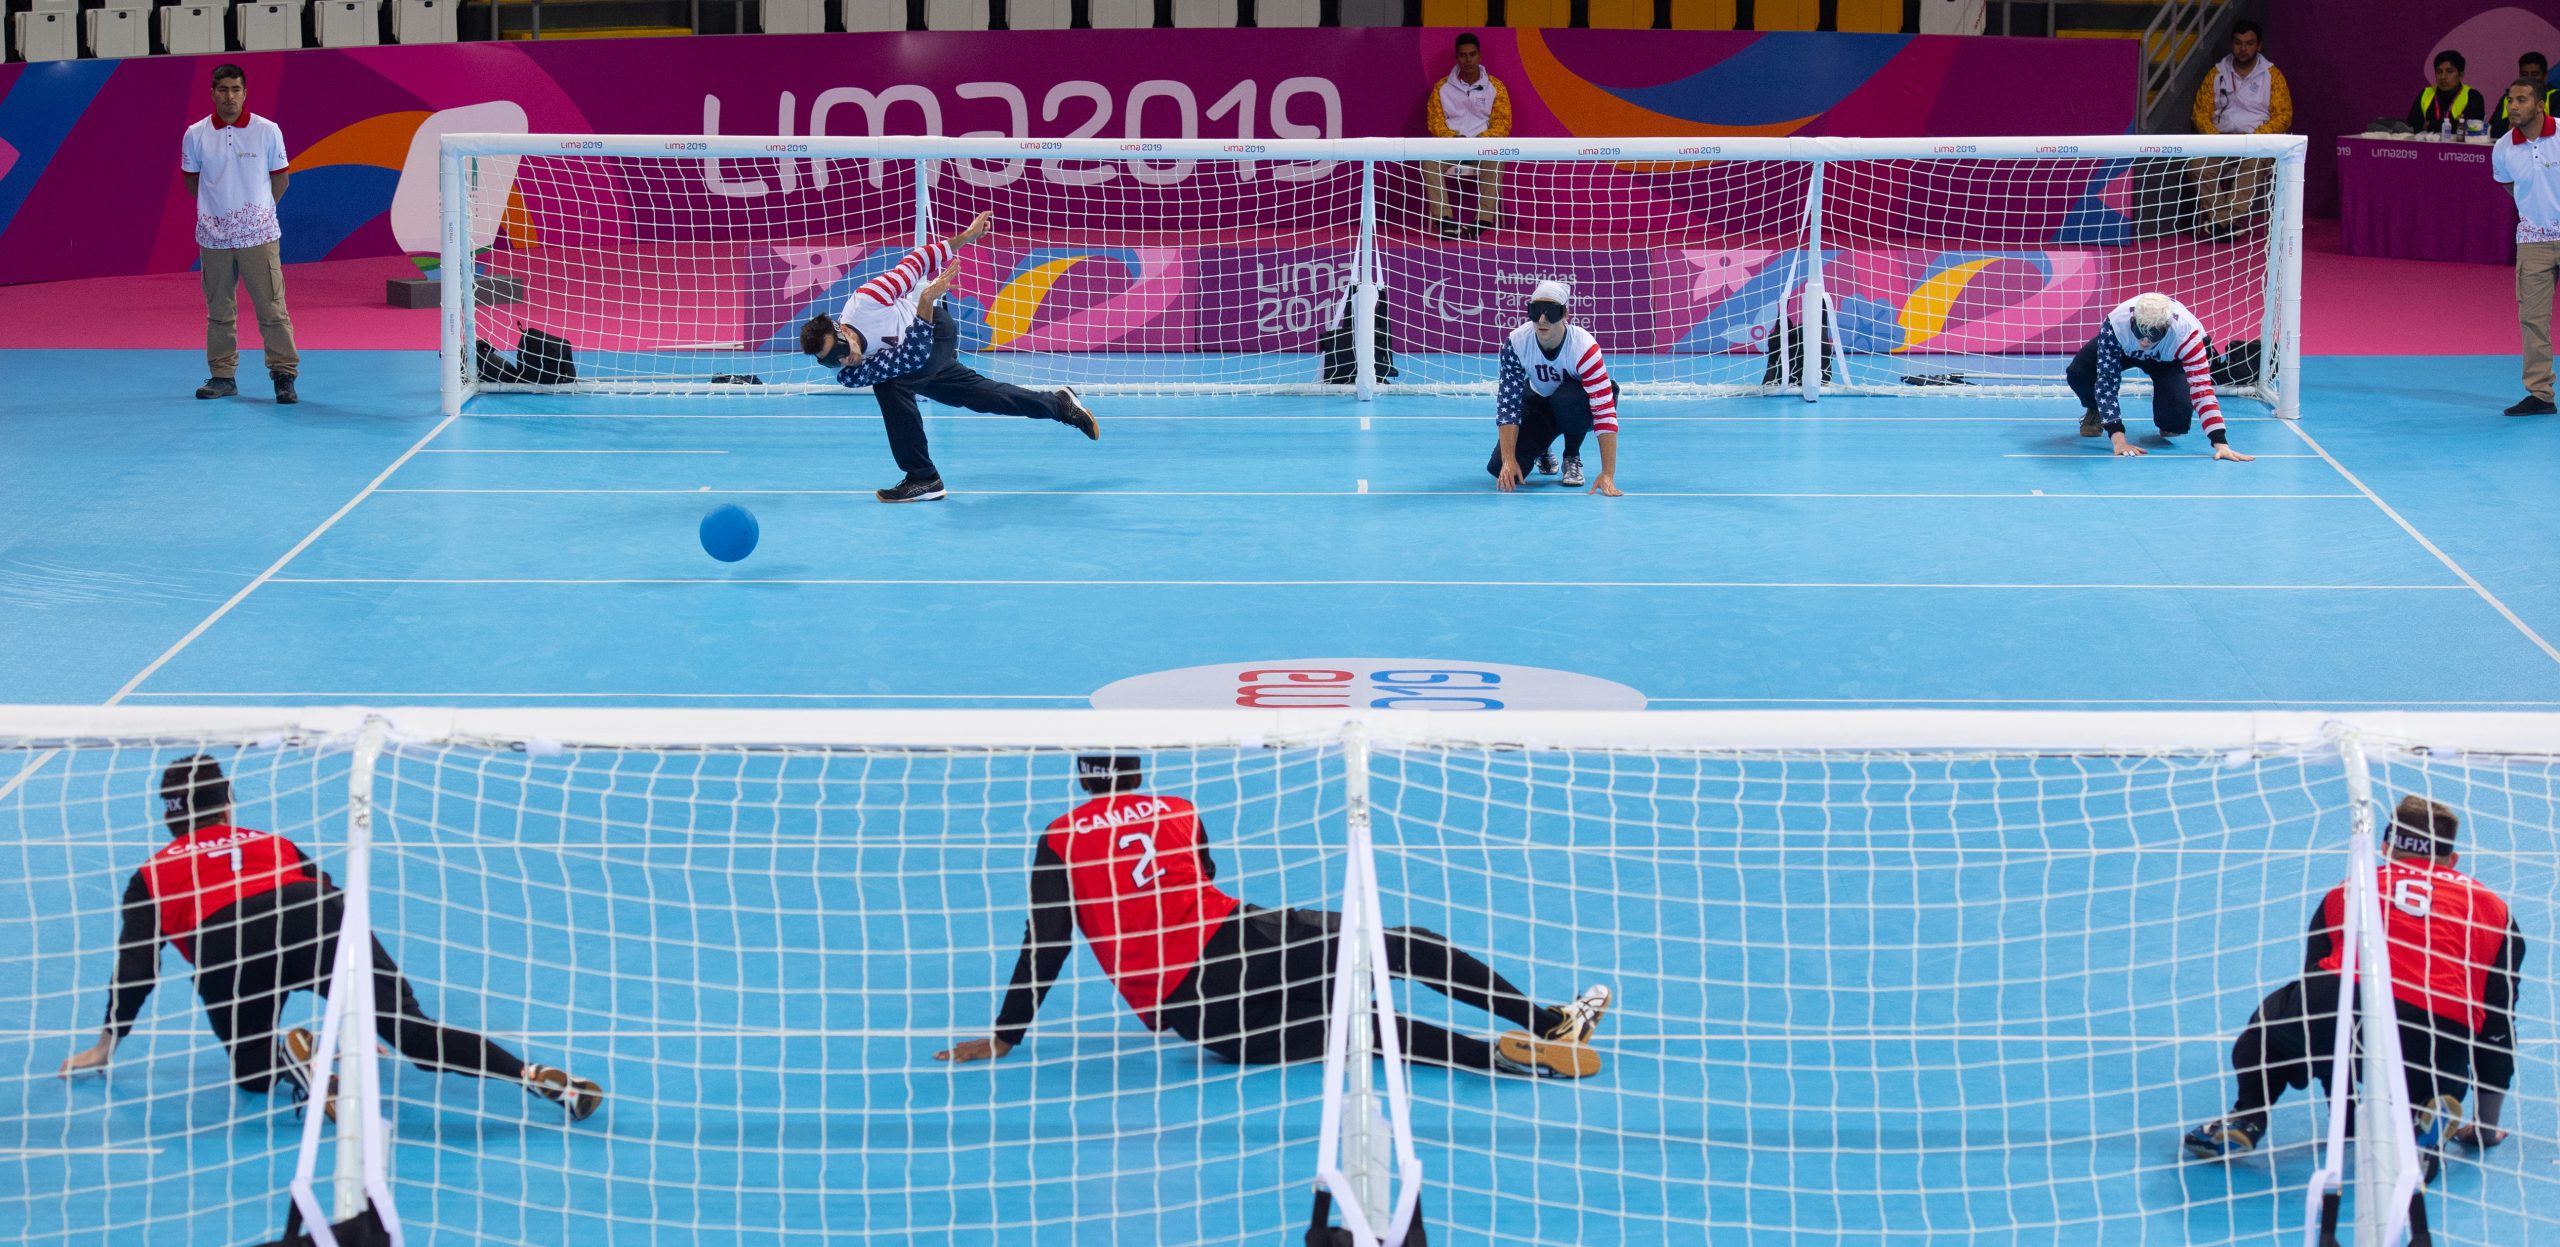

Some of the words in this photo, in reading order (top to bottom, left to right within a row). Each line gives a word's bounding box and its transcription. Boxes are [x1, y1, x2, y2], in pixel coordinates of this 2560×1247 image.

[1494, 269, 1577, 285] Americas
[1495, 292, 1593, 307] Parapic
[1258, 298, 1344, 332] 201
[1535, 364, 1571, 382] USA
[1075, 799, 1171, 834] CANADA
[207, 847, 243, 872] 7
[1118, 832, 1166, 888] 2
[2394, 879, 2433, 917] 6
